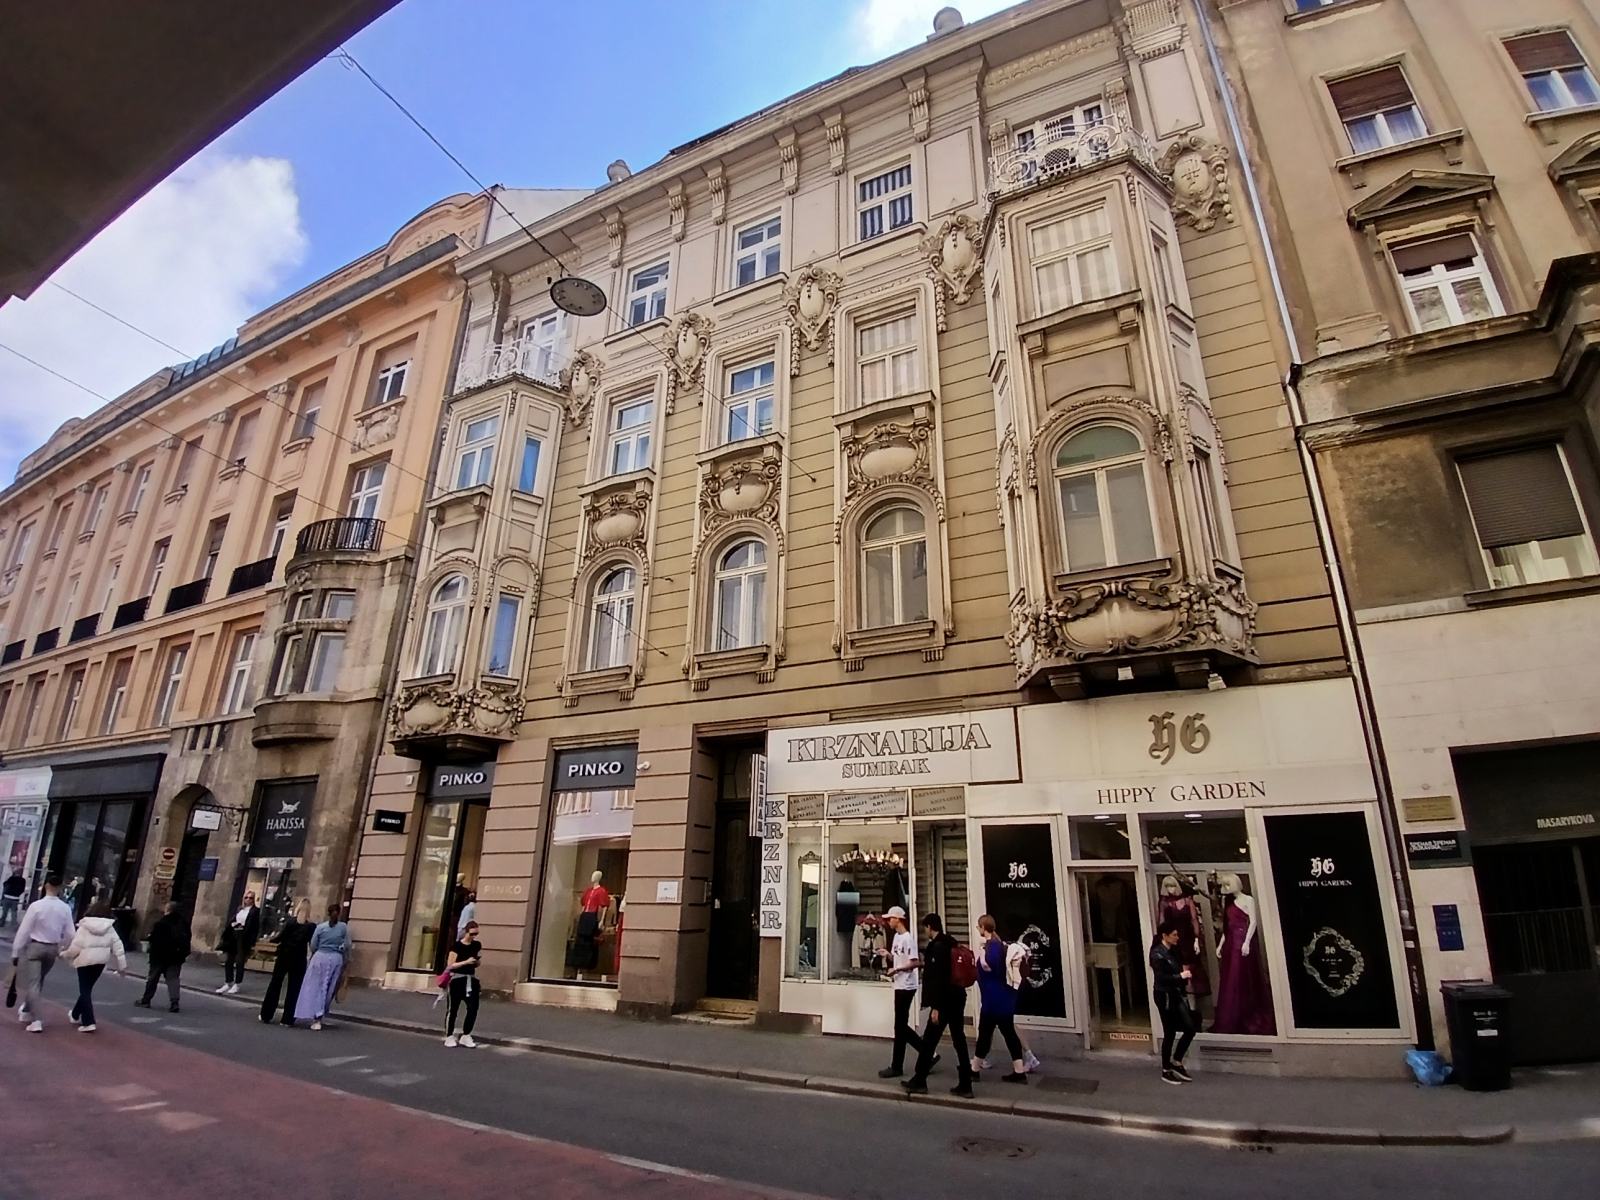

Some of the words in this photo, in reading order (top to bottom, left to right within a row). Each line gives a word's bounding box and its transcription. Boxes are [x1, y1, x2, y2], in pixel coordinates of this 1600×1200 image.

[788, 723, 991, 762] KRZNARIJA
[568, 761, 622, 777] PINKO
[841, 757, 931, 779] SUMRAK
[439, 772, 485, 787] PINKO
[1097, 786, 1156, 805] HIPPY
[1170, 781, 1267, 802] GARDEN
[265, 816, 305, 831] HARISSA
[380, 816, 401, 825] PINKO
[1536, 814, 1595, 828] MASARYKOVA
[761, 800, 786, 930] KRZNAR
[483, 884, 523, 896] PINKO
